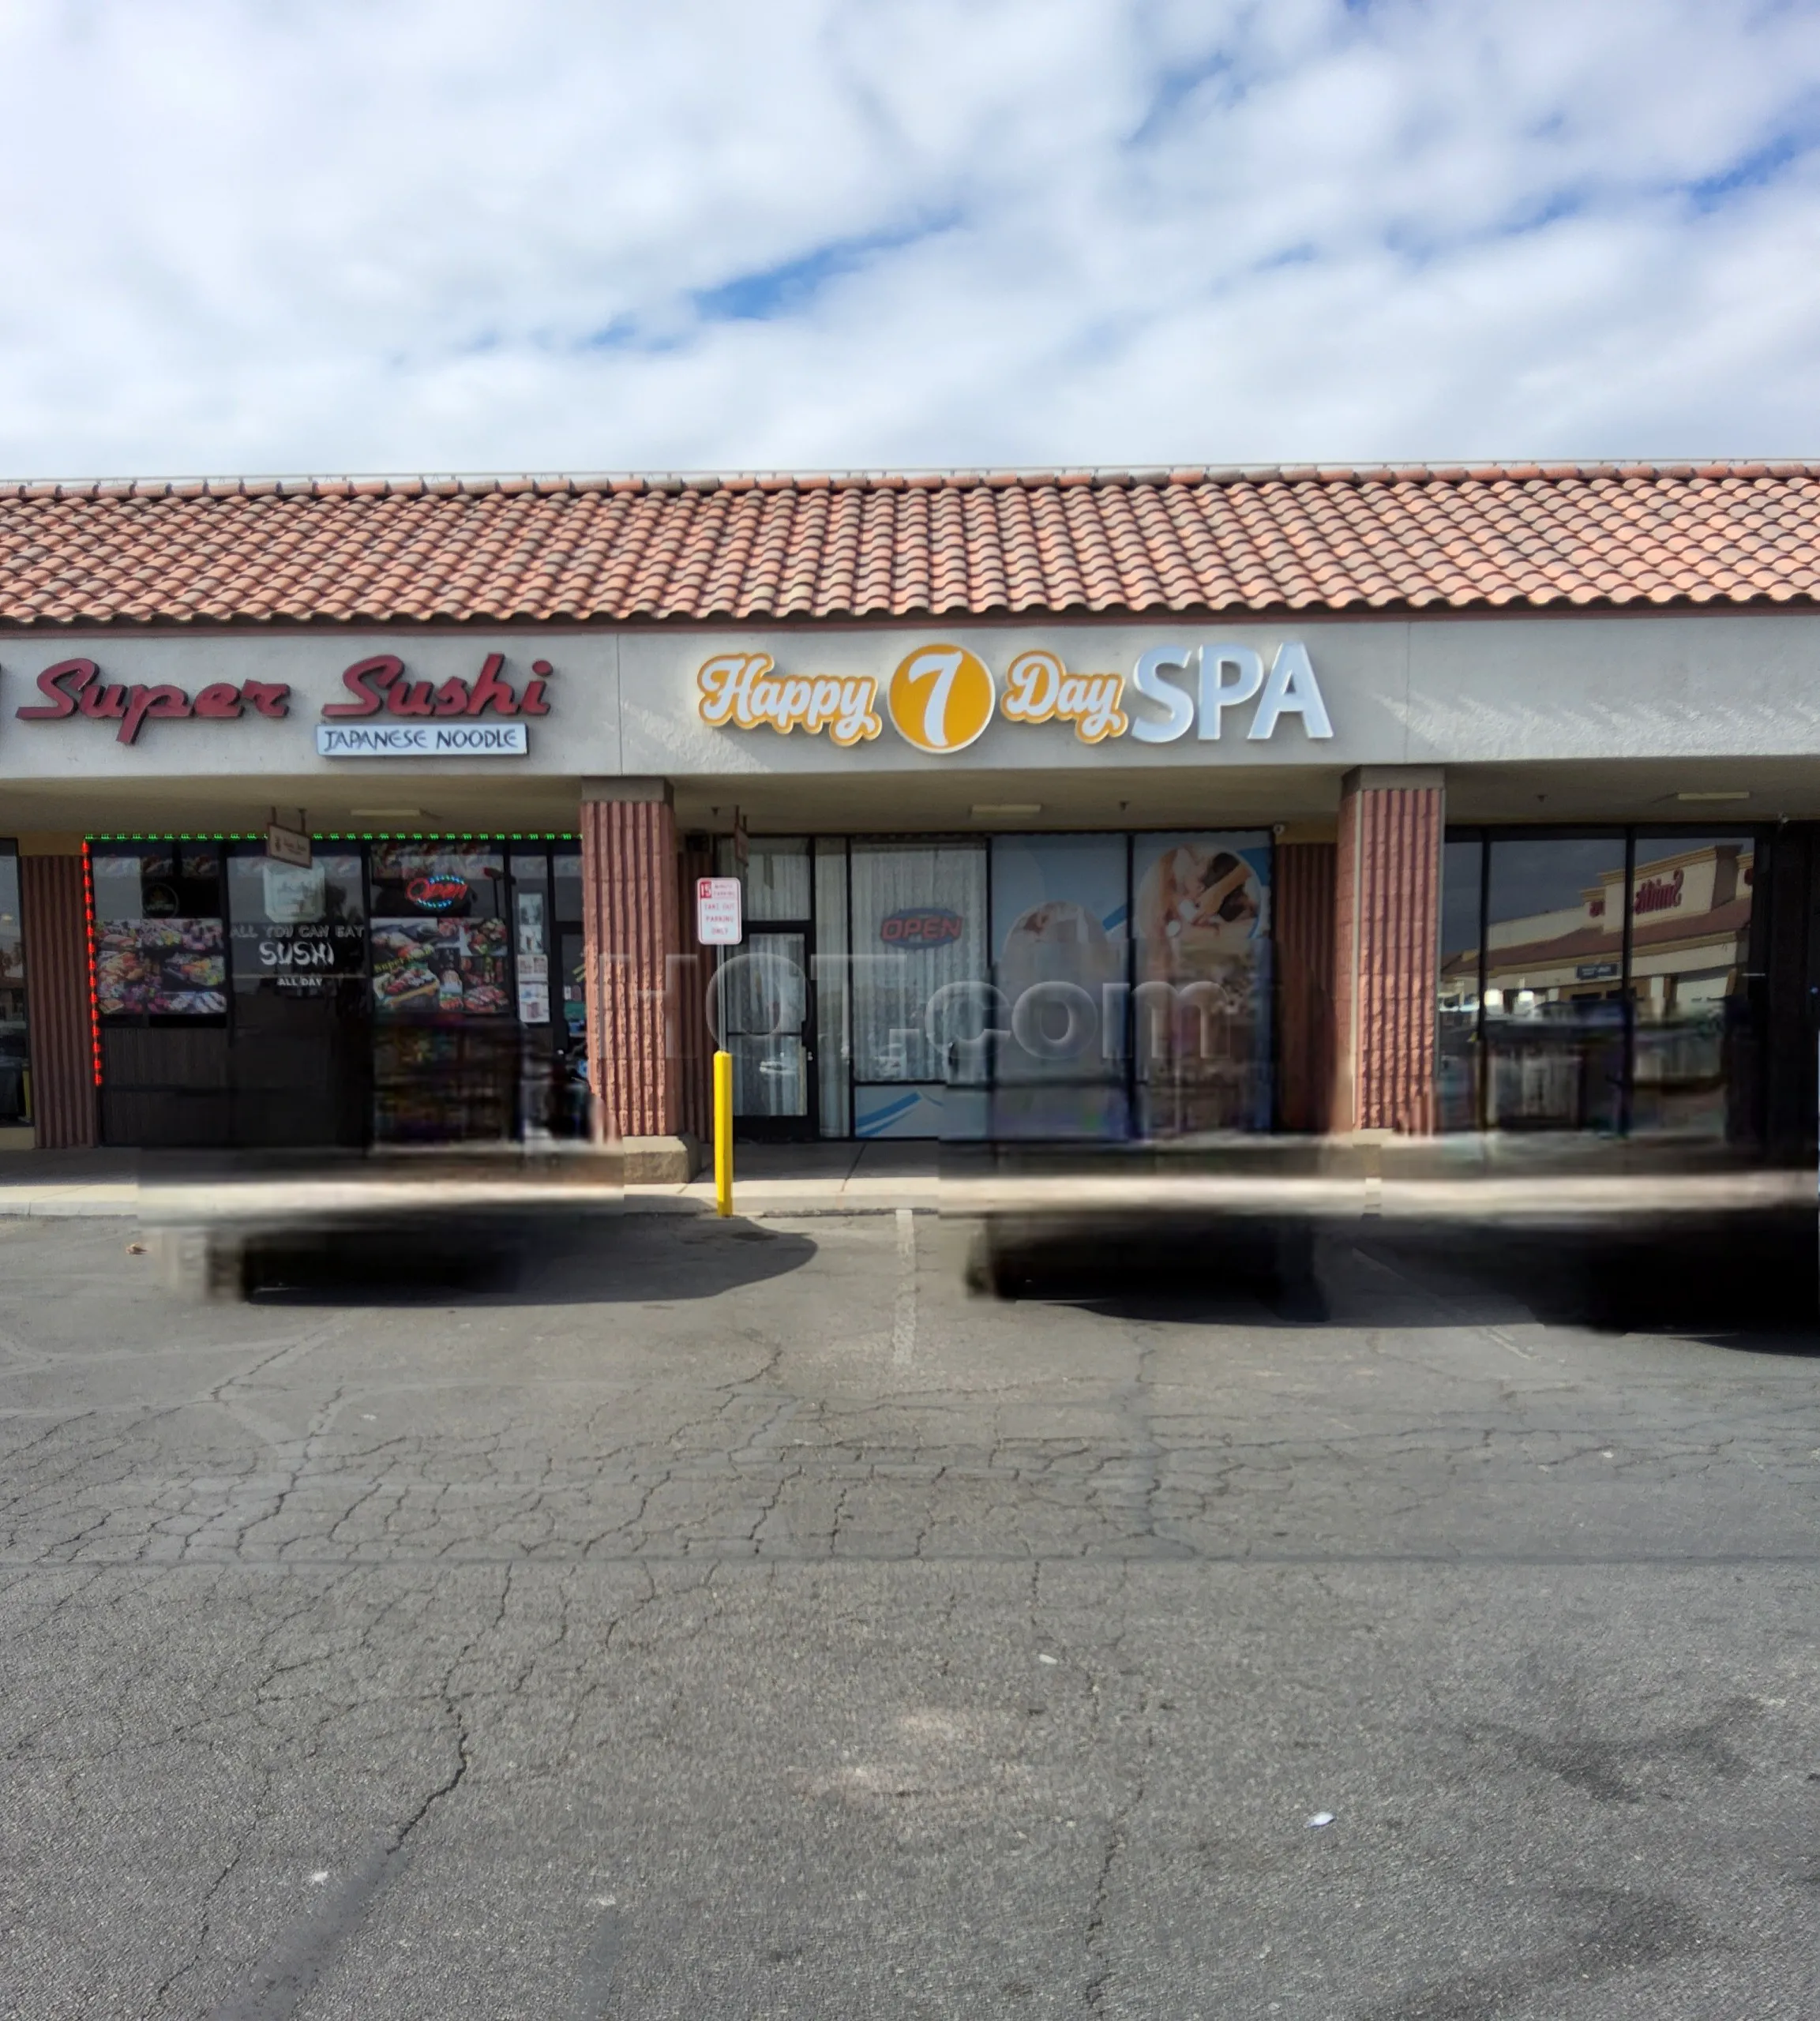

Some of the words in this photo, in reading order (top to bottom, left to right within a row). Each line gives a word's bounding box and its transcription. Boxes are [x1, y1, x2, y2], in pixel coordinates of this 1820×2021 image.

[16, 658, 291, 744] Super
[321, 652, 554, 717] Sushi
[698, 650, 883, 746] Happy
[906, 652, 965, 748] 7
[1000, 649, 1129, 744] Day
[1130, 640, 1334, 742] SPA
[324, 728, 427, 750] JAPANESE
[435, 729, 518, 750] NOODLE
[700, 883, 711, 898] 15
[230, 925, 258, 939] ALL
[265, 925, 294, 939] YOU
[298, 925, 329, 939] CAN
[335, 925, 364, 939] EAT
[880, 916, 963, 941] OPEN
[259, 941, 335, 966] SUSHI
[276, 977, 299, 986] ALL
[300, 977, 323, 986] DAY
